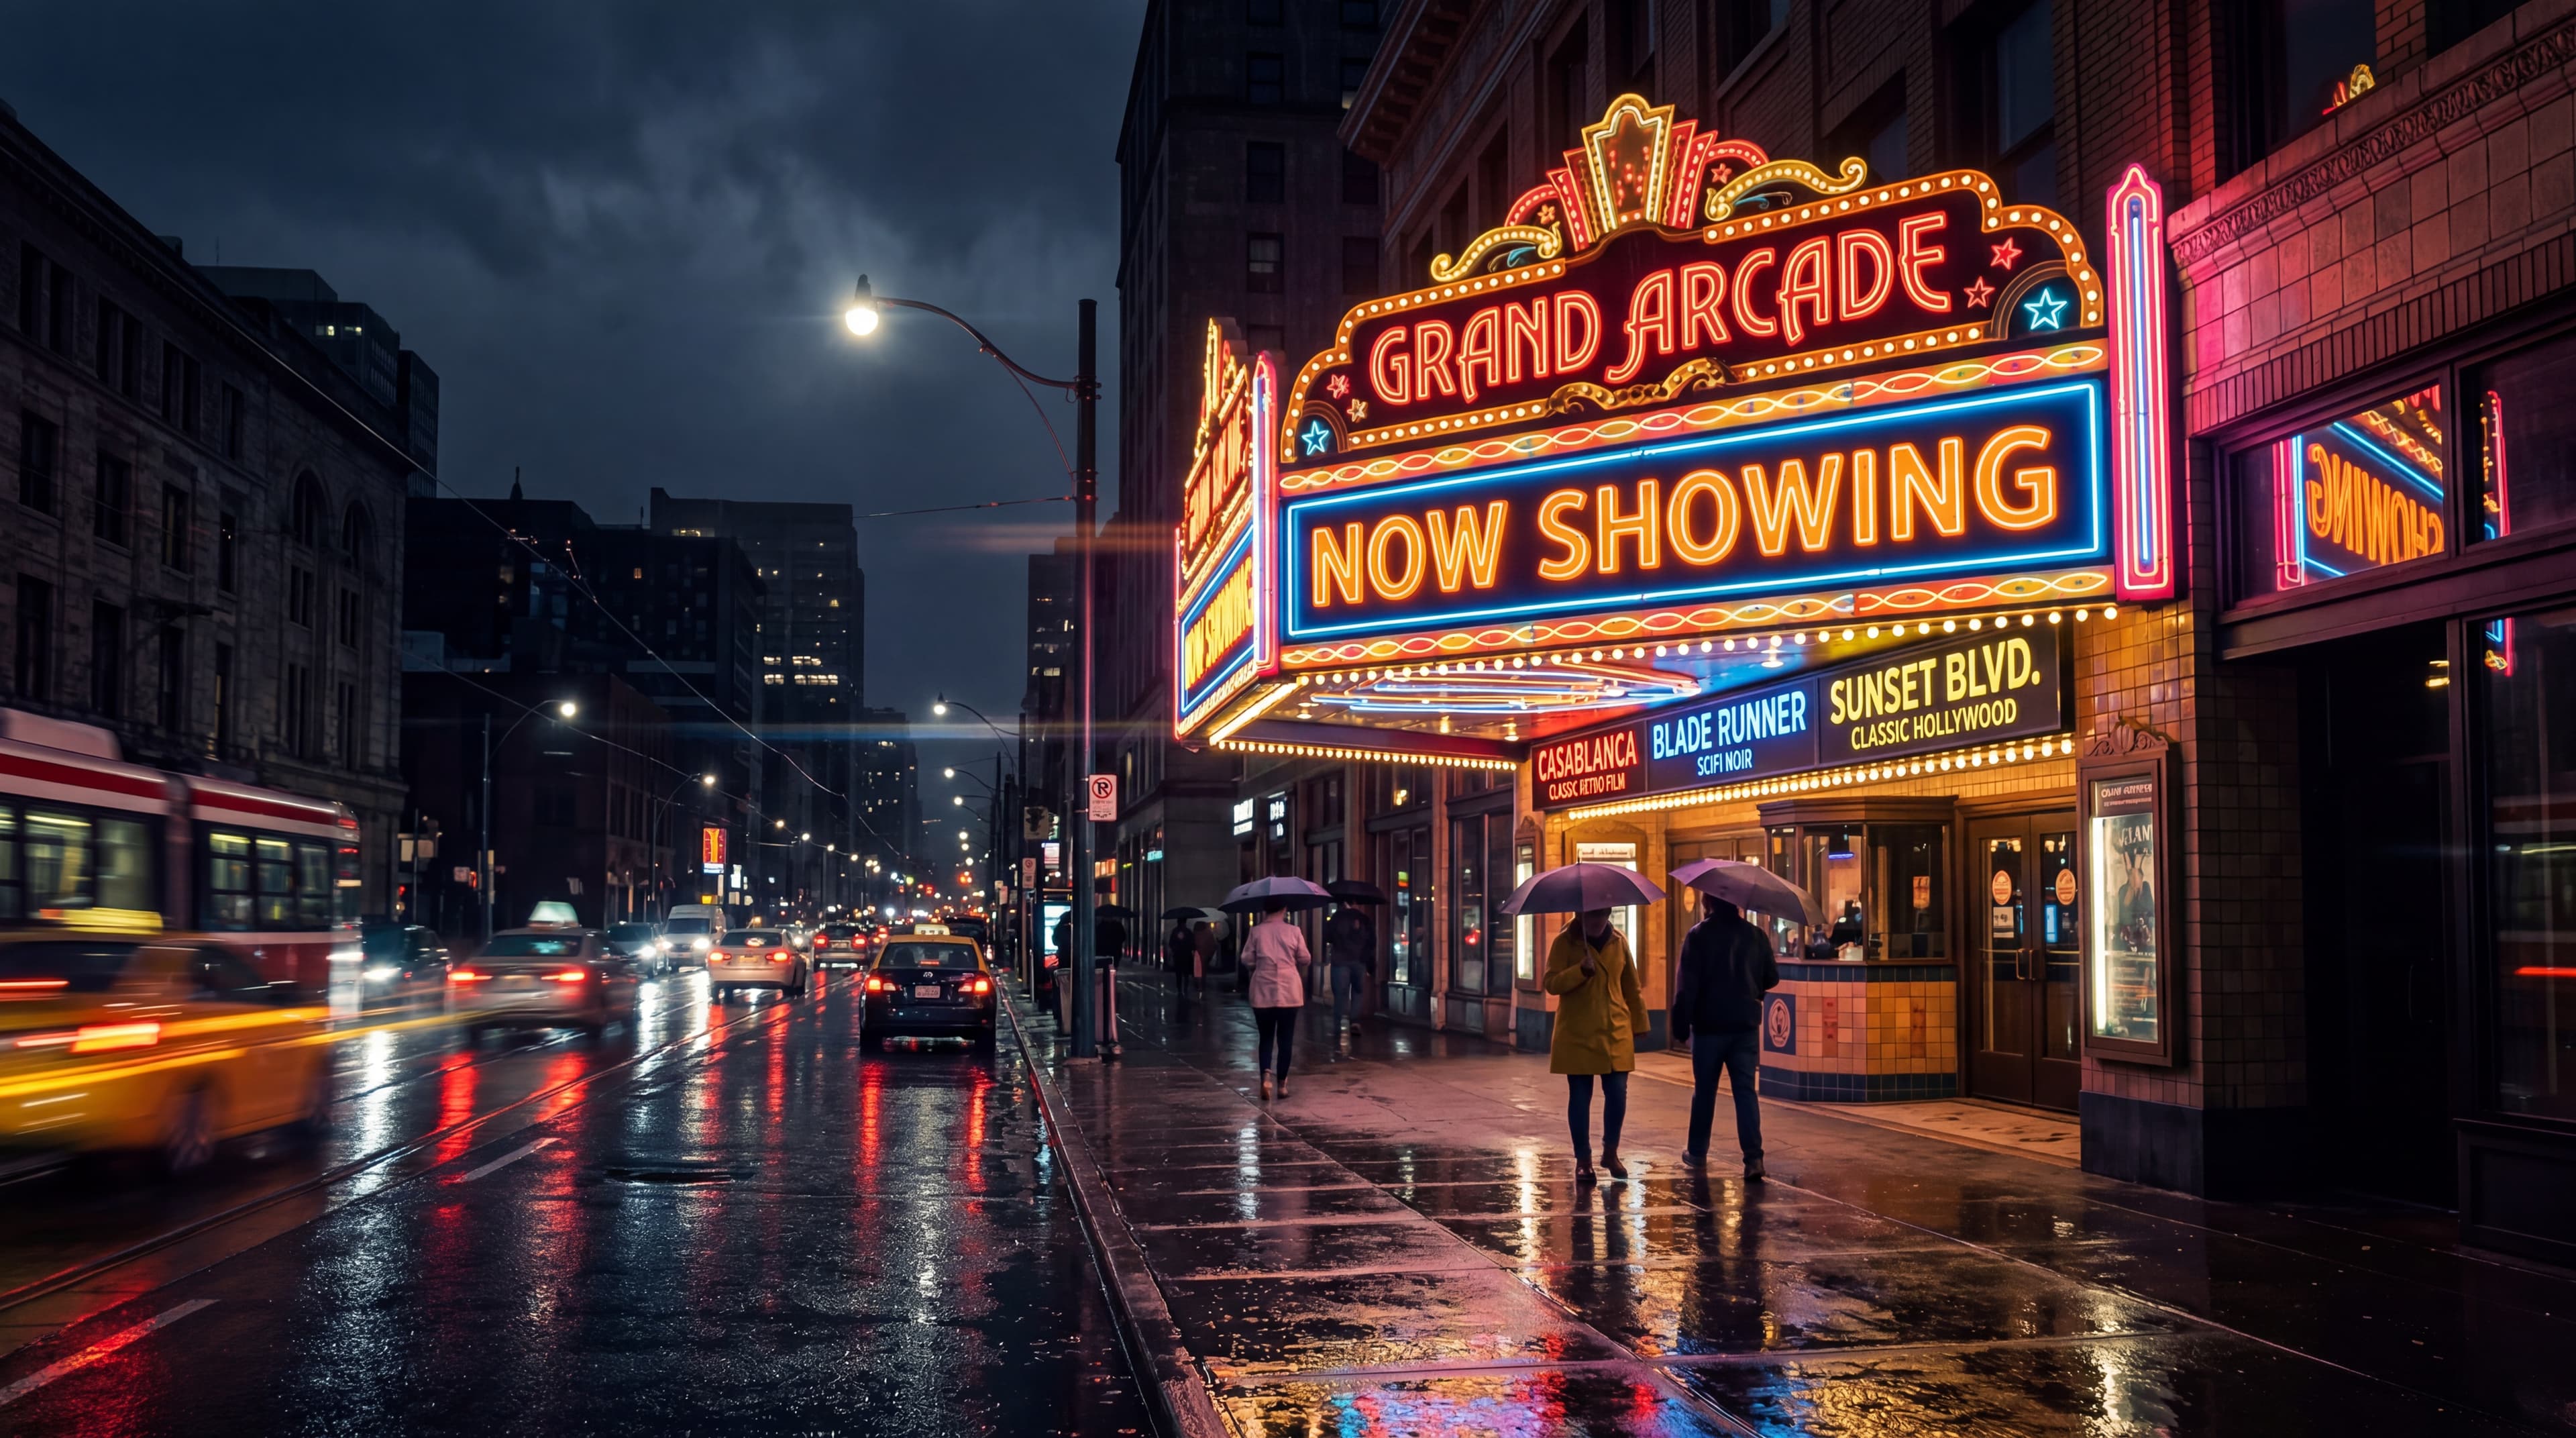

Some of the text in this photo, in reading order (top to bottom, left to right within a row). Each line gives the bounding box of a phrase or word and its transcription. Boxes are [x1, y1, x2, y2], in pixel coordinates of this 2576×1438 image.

[1369, 211, 1951, 405] GRAND ARCADE
[1312, 500, 1508, 607] NOW
[1538, 425, 2057, 581] SHOWING
[1830, 637, 2041, 725] SUNSET BLVD.
[1653, 690, 1807, 760] BLADE RUNNER
[1851, 698, 2017, 750] CLASSIC HOLLYWOOD
[1538, 731, 1638, 782] CASABLANCA
[1606, 772, 1625, 792] FILM
[1697, 748, 1753, 776] SCIFI NOIR
